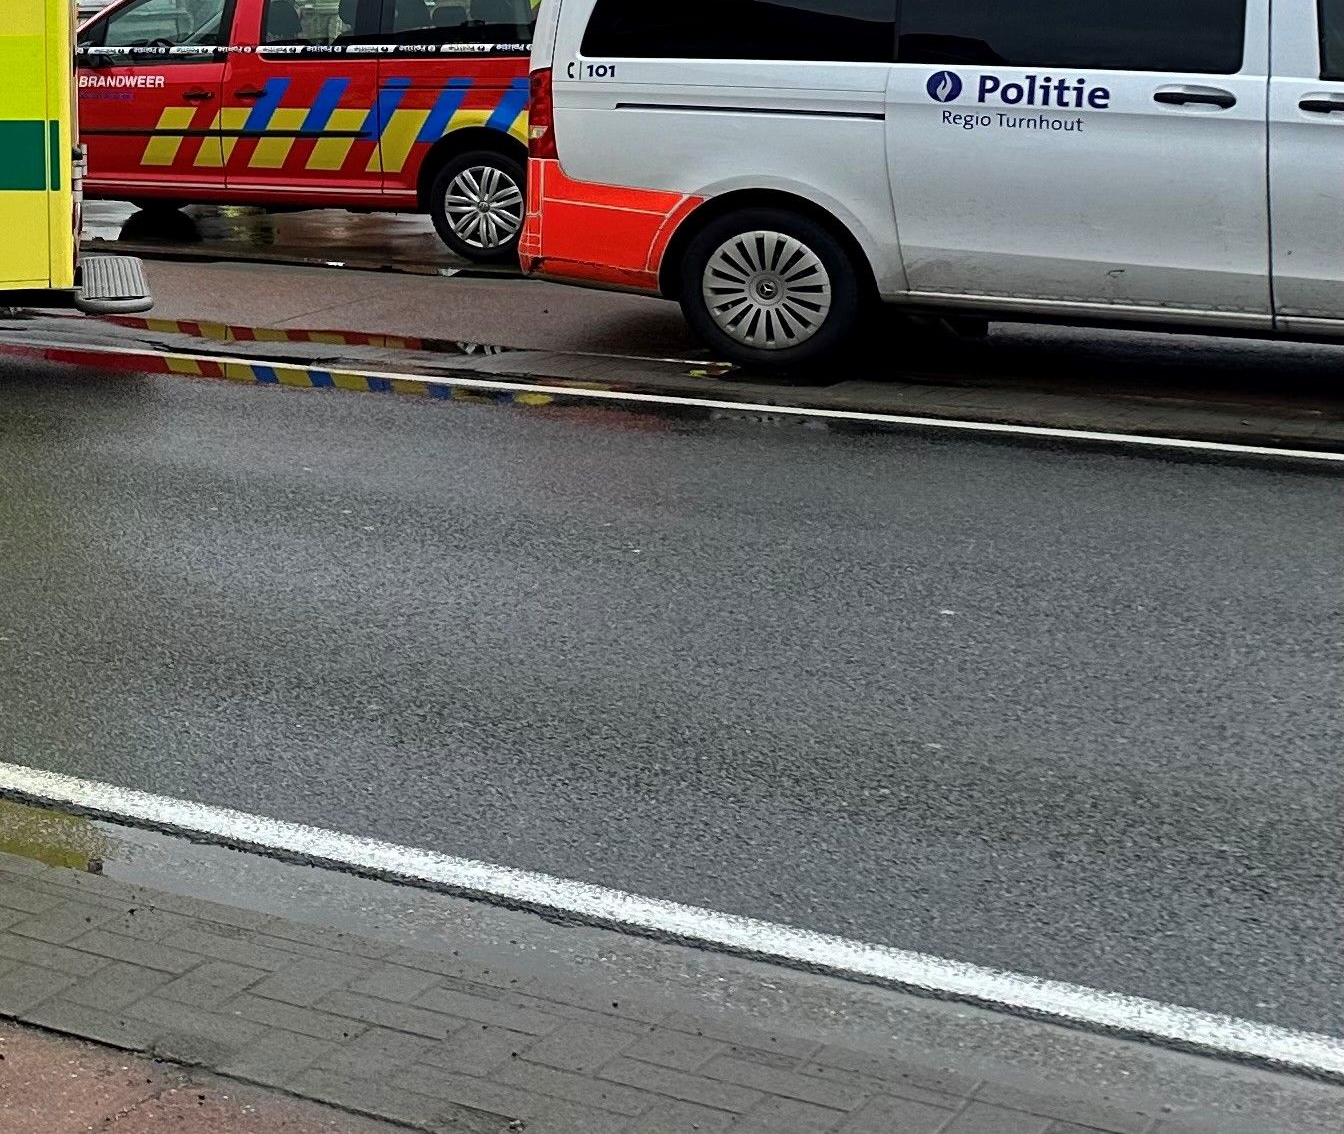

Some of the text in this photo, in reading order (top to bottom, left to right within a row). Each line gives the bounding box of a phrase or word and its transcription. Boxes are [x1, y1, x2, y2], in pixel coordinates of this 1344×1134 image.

[587, 64, 616, 78] 101
[79, 75, 165, 88] BRANDWEER
[978, 74, 1111, 109] Politie
[942, 110, 1084, 133] Regio Turnhout
